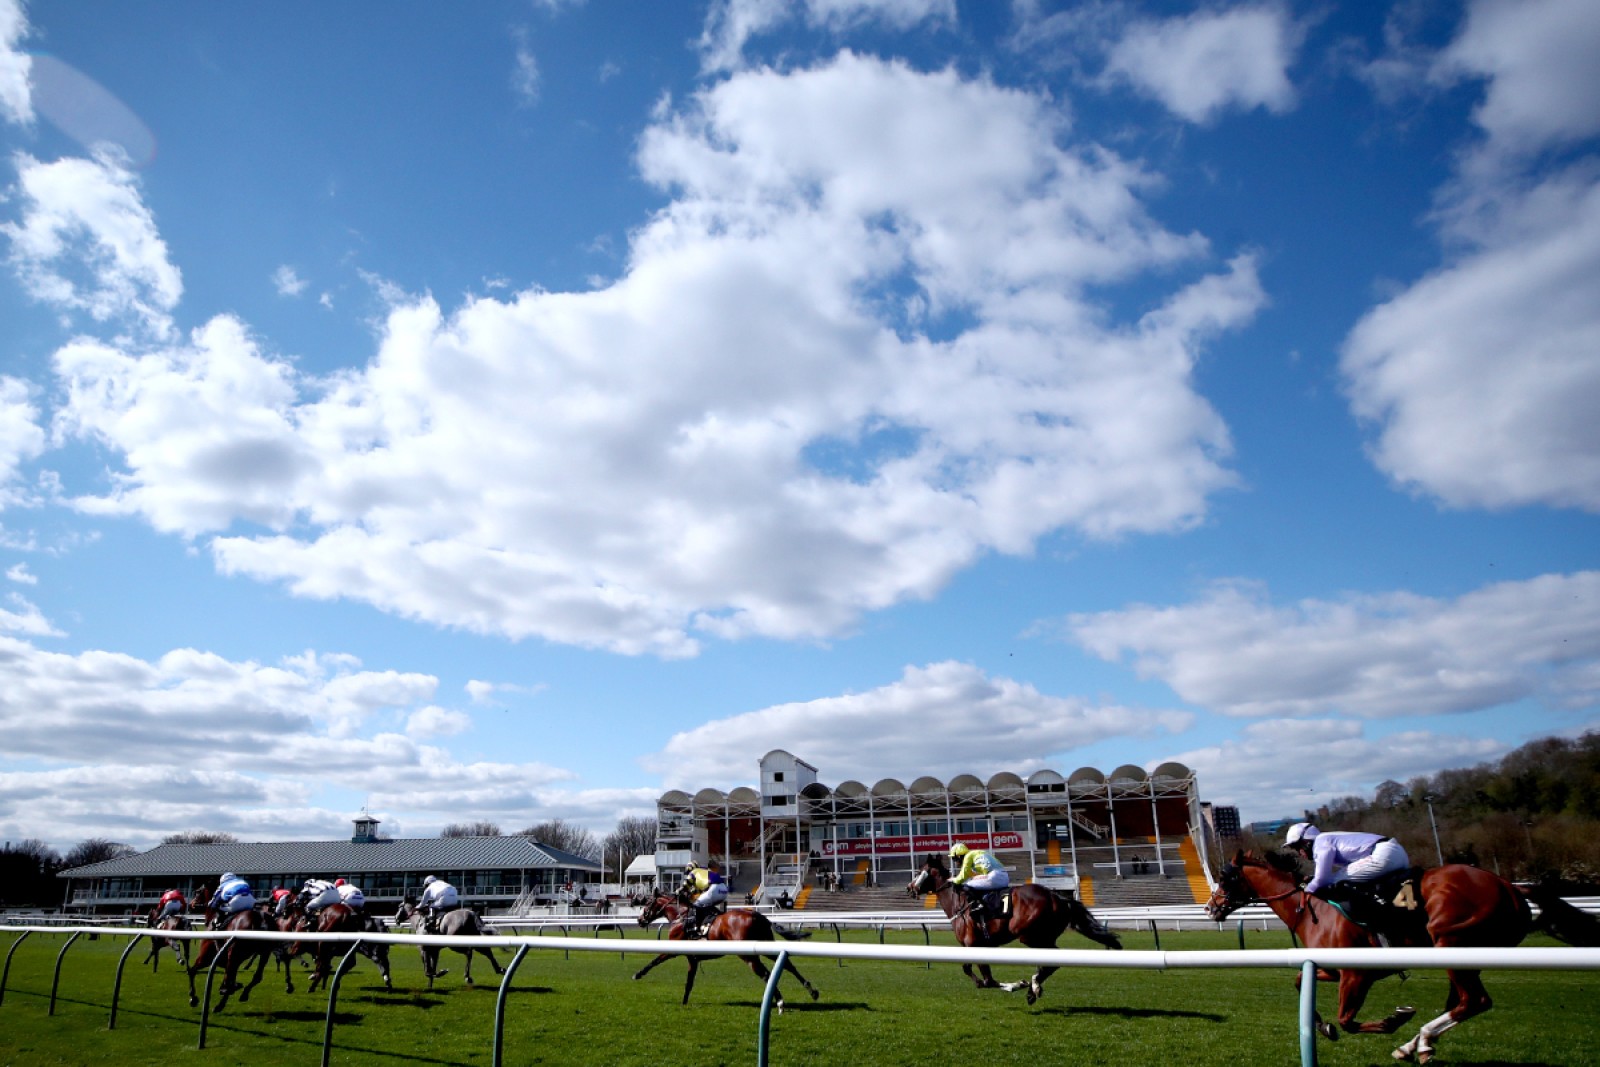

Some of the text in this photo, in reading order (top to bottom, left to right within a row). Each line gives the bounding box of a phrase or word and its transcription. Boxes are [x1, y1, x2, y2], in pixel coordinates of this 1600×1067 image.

[994, 835, 1019, 847] gem
[1001, 895, 1009, 913] 1
[1392, 884, 1418, 911] 4
